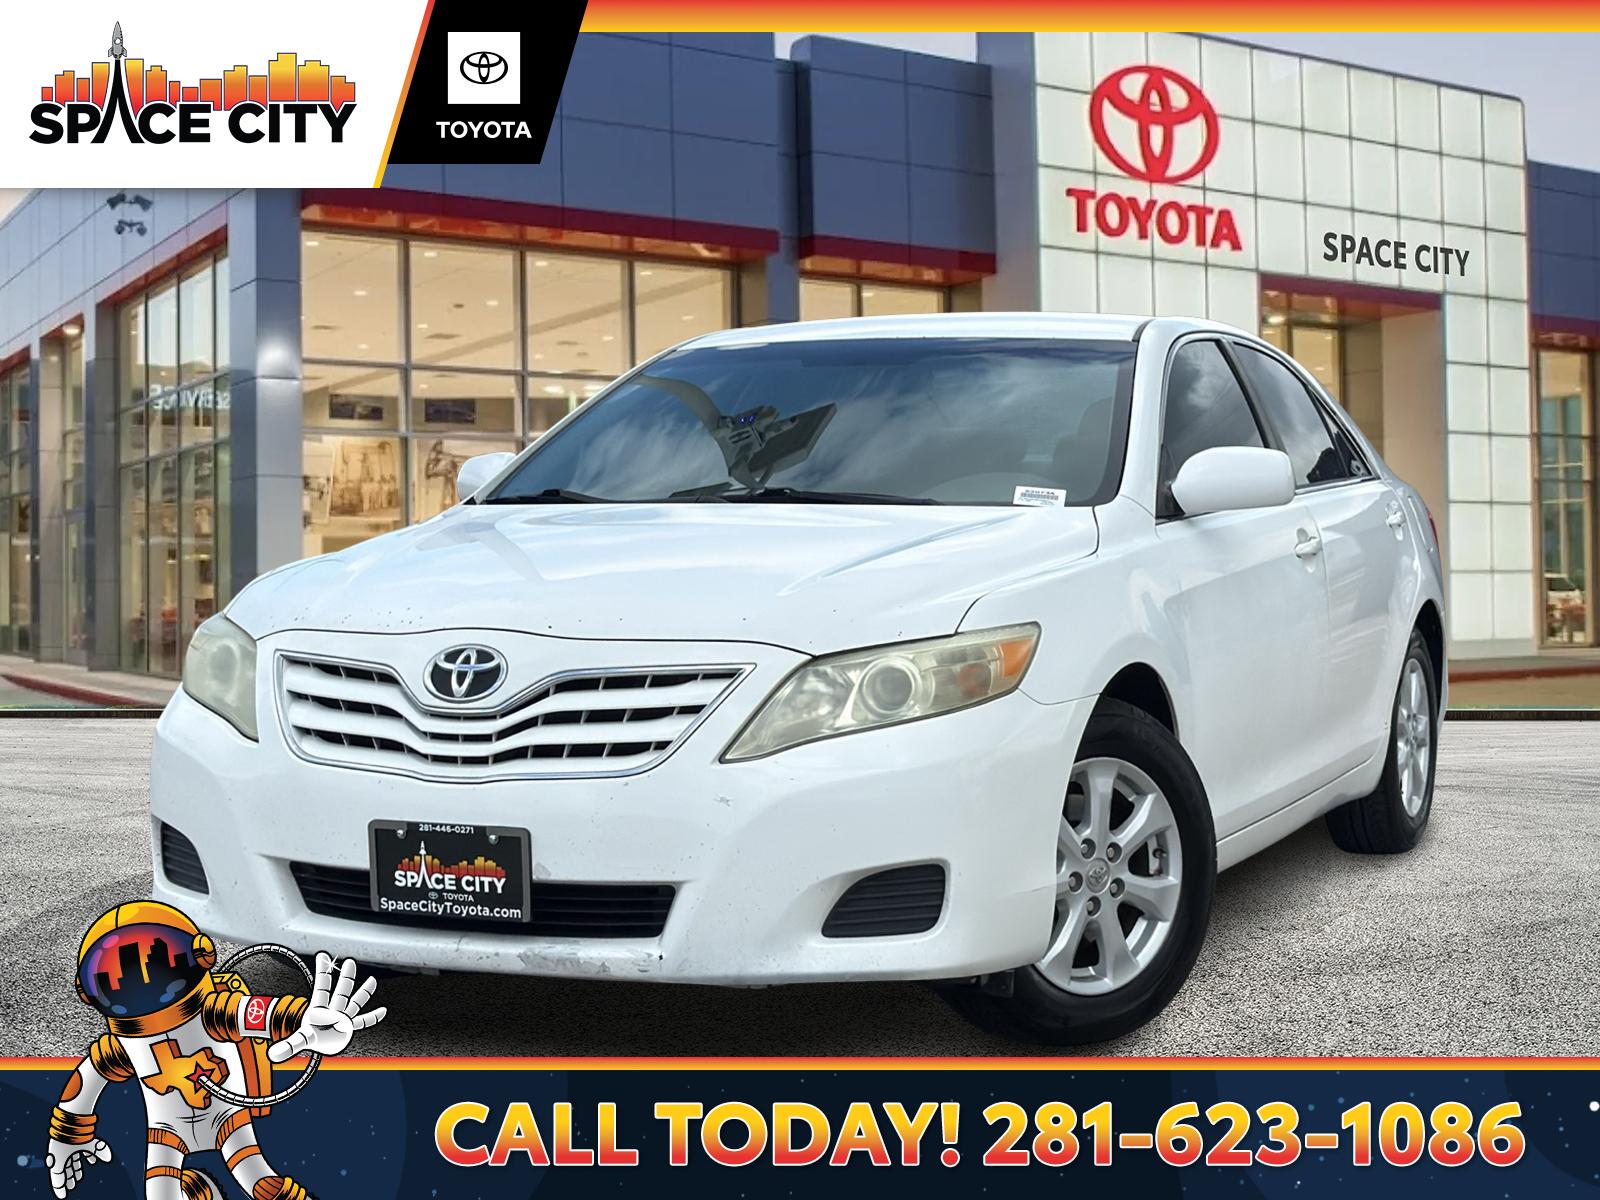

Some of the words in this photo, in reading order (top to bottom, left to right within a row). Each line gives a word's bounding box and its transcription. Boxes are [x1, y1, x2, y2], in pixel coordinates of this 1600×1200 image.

[1066, 187, 1243, 251] TOYOTA
[1322, 231, 1407, 270] SPACE
[1414, 245, 1471, 277] CITY
[394, 866, 457, 891] SPACE
[461, 875, 507, 894] CITY
[380, 897, 522, 919] SpaceCityToyota.com
[442, 891, 475, 903] TOYOTA
